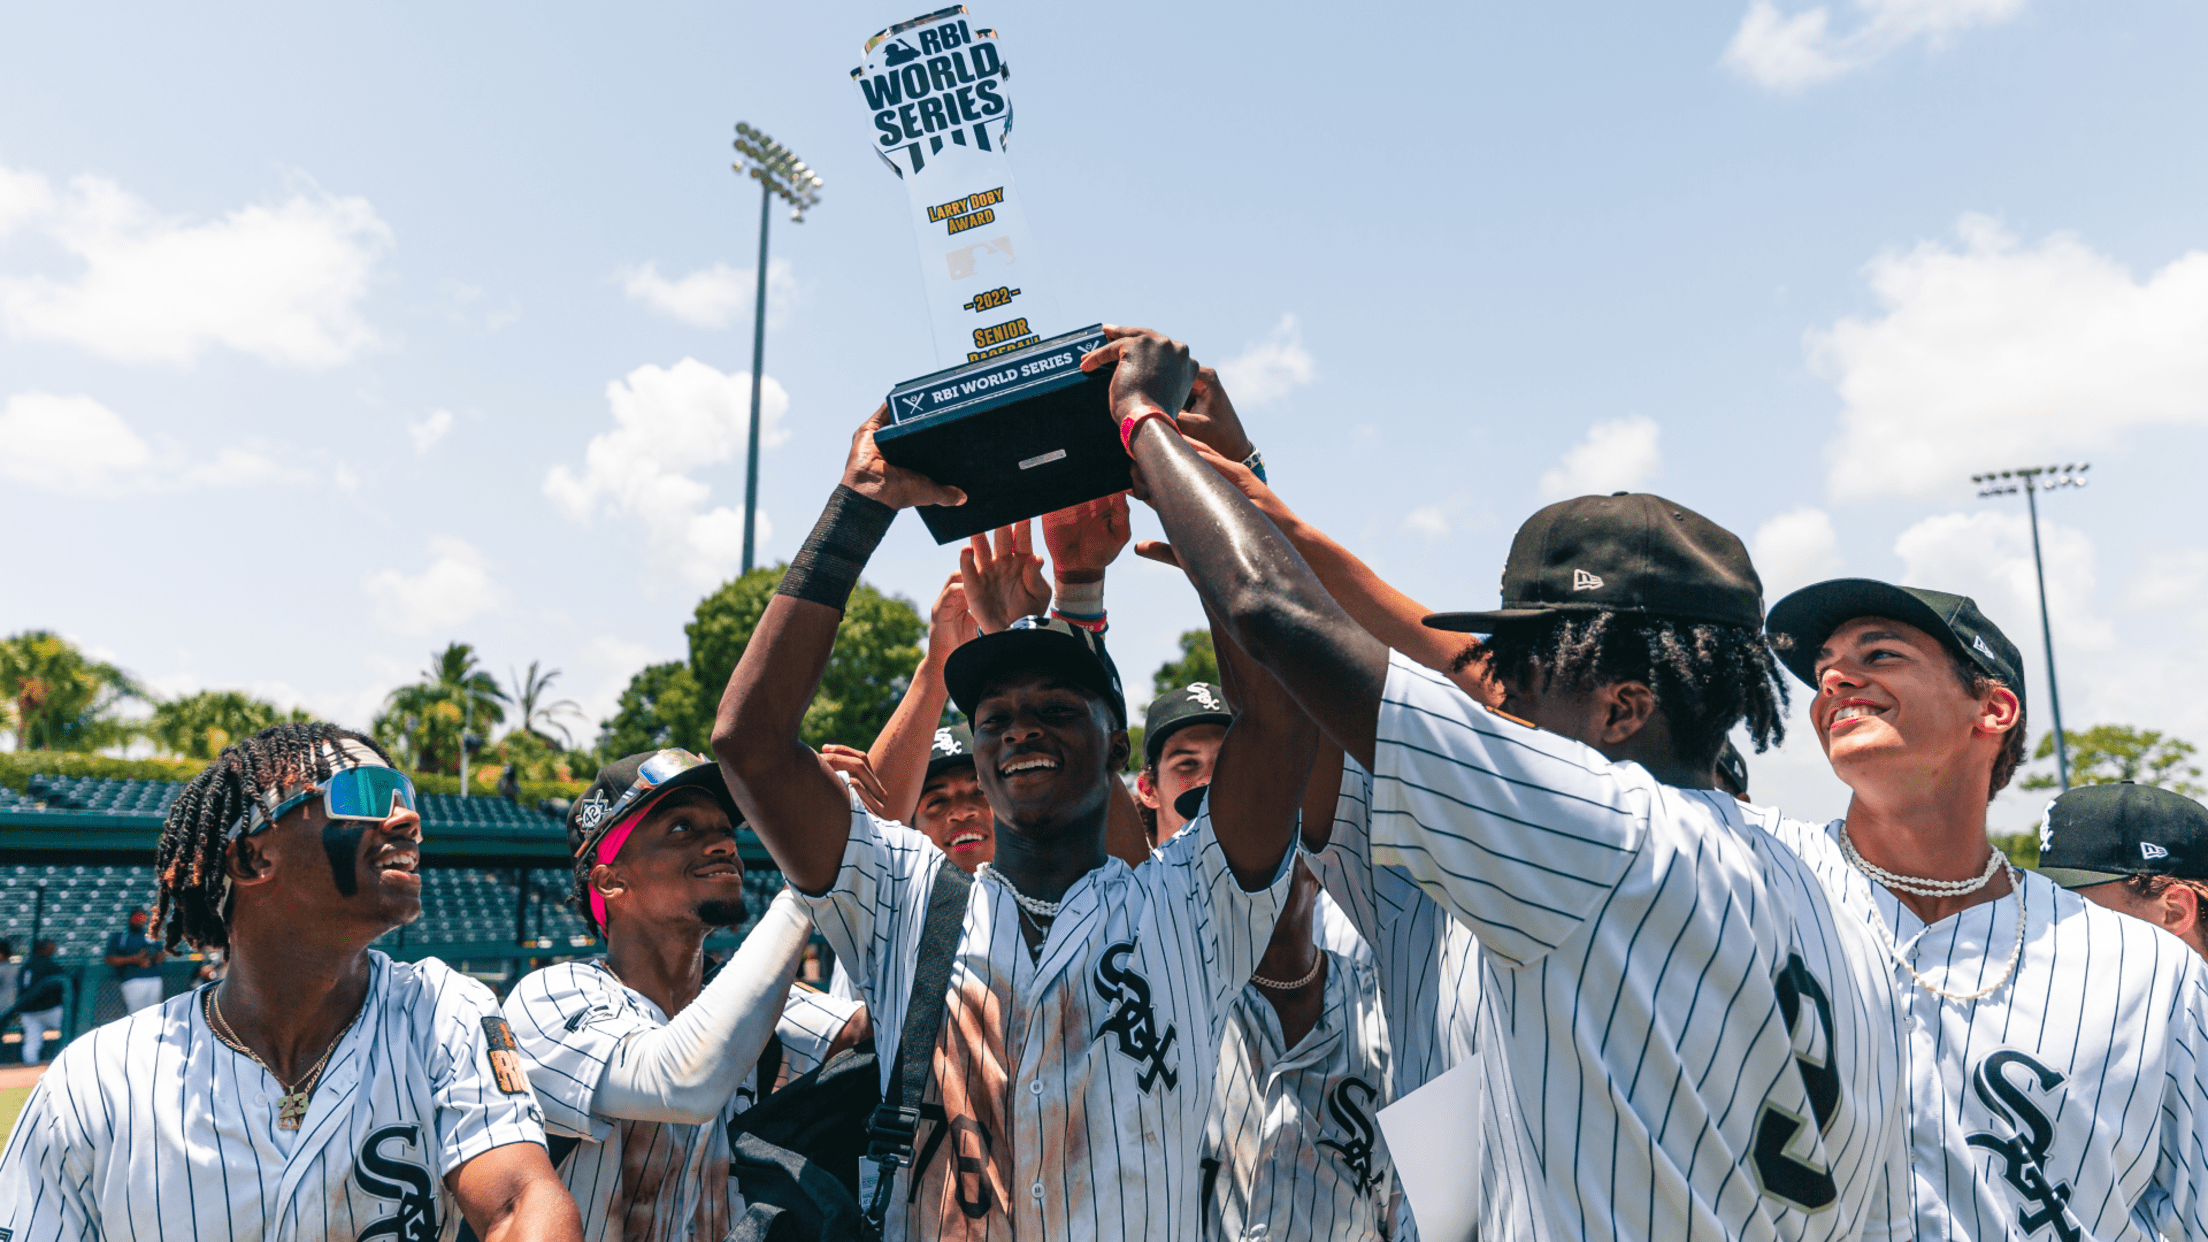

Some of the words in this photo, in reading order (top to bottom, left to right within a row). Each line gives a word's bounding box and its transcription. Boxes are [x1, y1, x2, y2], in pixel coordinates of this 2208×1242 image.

[918, 19, 972, 56] RBI
[859, 42, 1001, 111] WORLD
[874, 79, 1005, 147] SERIES
[927, 197, 969, 223] LARRY
[968, 186, 1004, 211] DOBY
[947, 208, 996, 236] AWARD
[972, 317, 1033, 348] SENIOR
[931, 386, 960, 403] RBI
[960, 366, 1019, 395] WORLD
[1021, 352, 1073, 378] SERIES
[907, 1102, 993, 1220] 78
